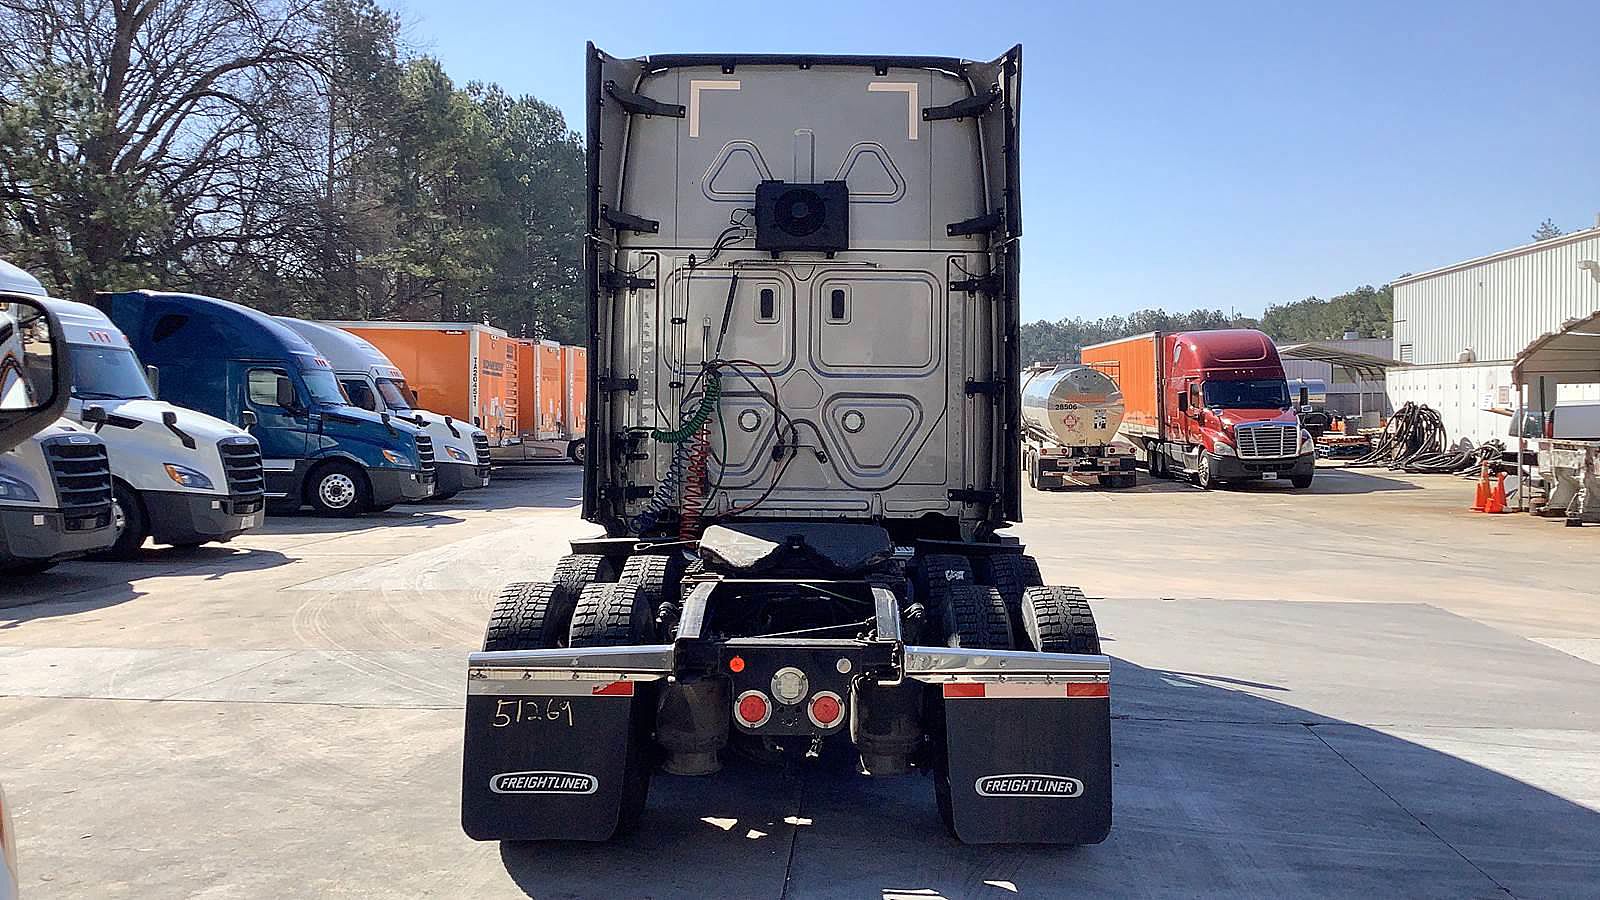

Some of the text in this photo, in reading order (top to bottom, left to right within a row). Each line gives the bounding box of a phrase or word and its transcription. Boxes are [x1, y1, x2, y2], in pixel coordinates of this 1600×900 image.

[1055, 403, 1078, 411] 28506
[492, 699, 572, 727] 51269
[500, 776, 589, 790] FREIGHTLINER
[985, 779, 1073, 793] FREIGHTLINER
